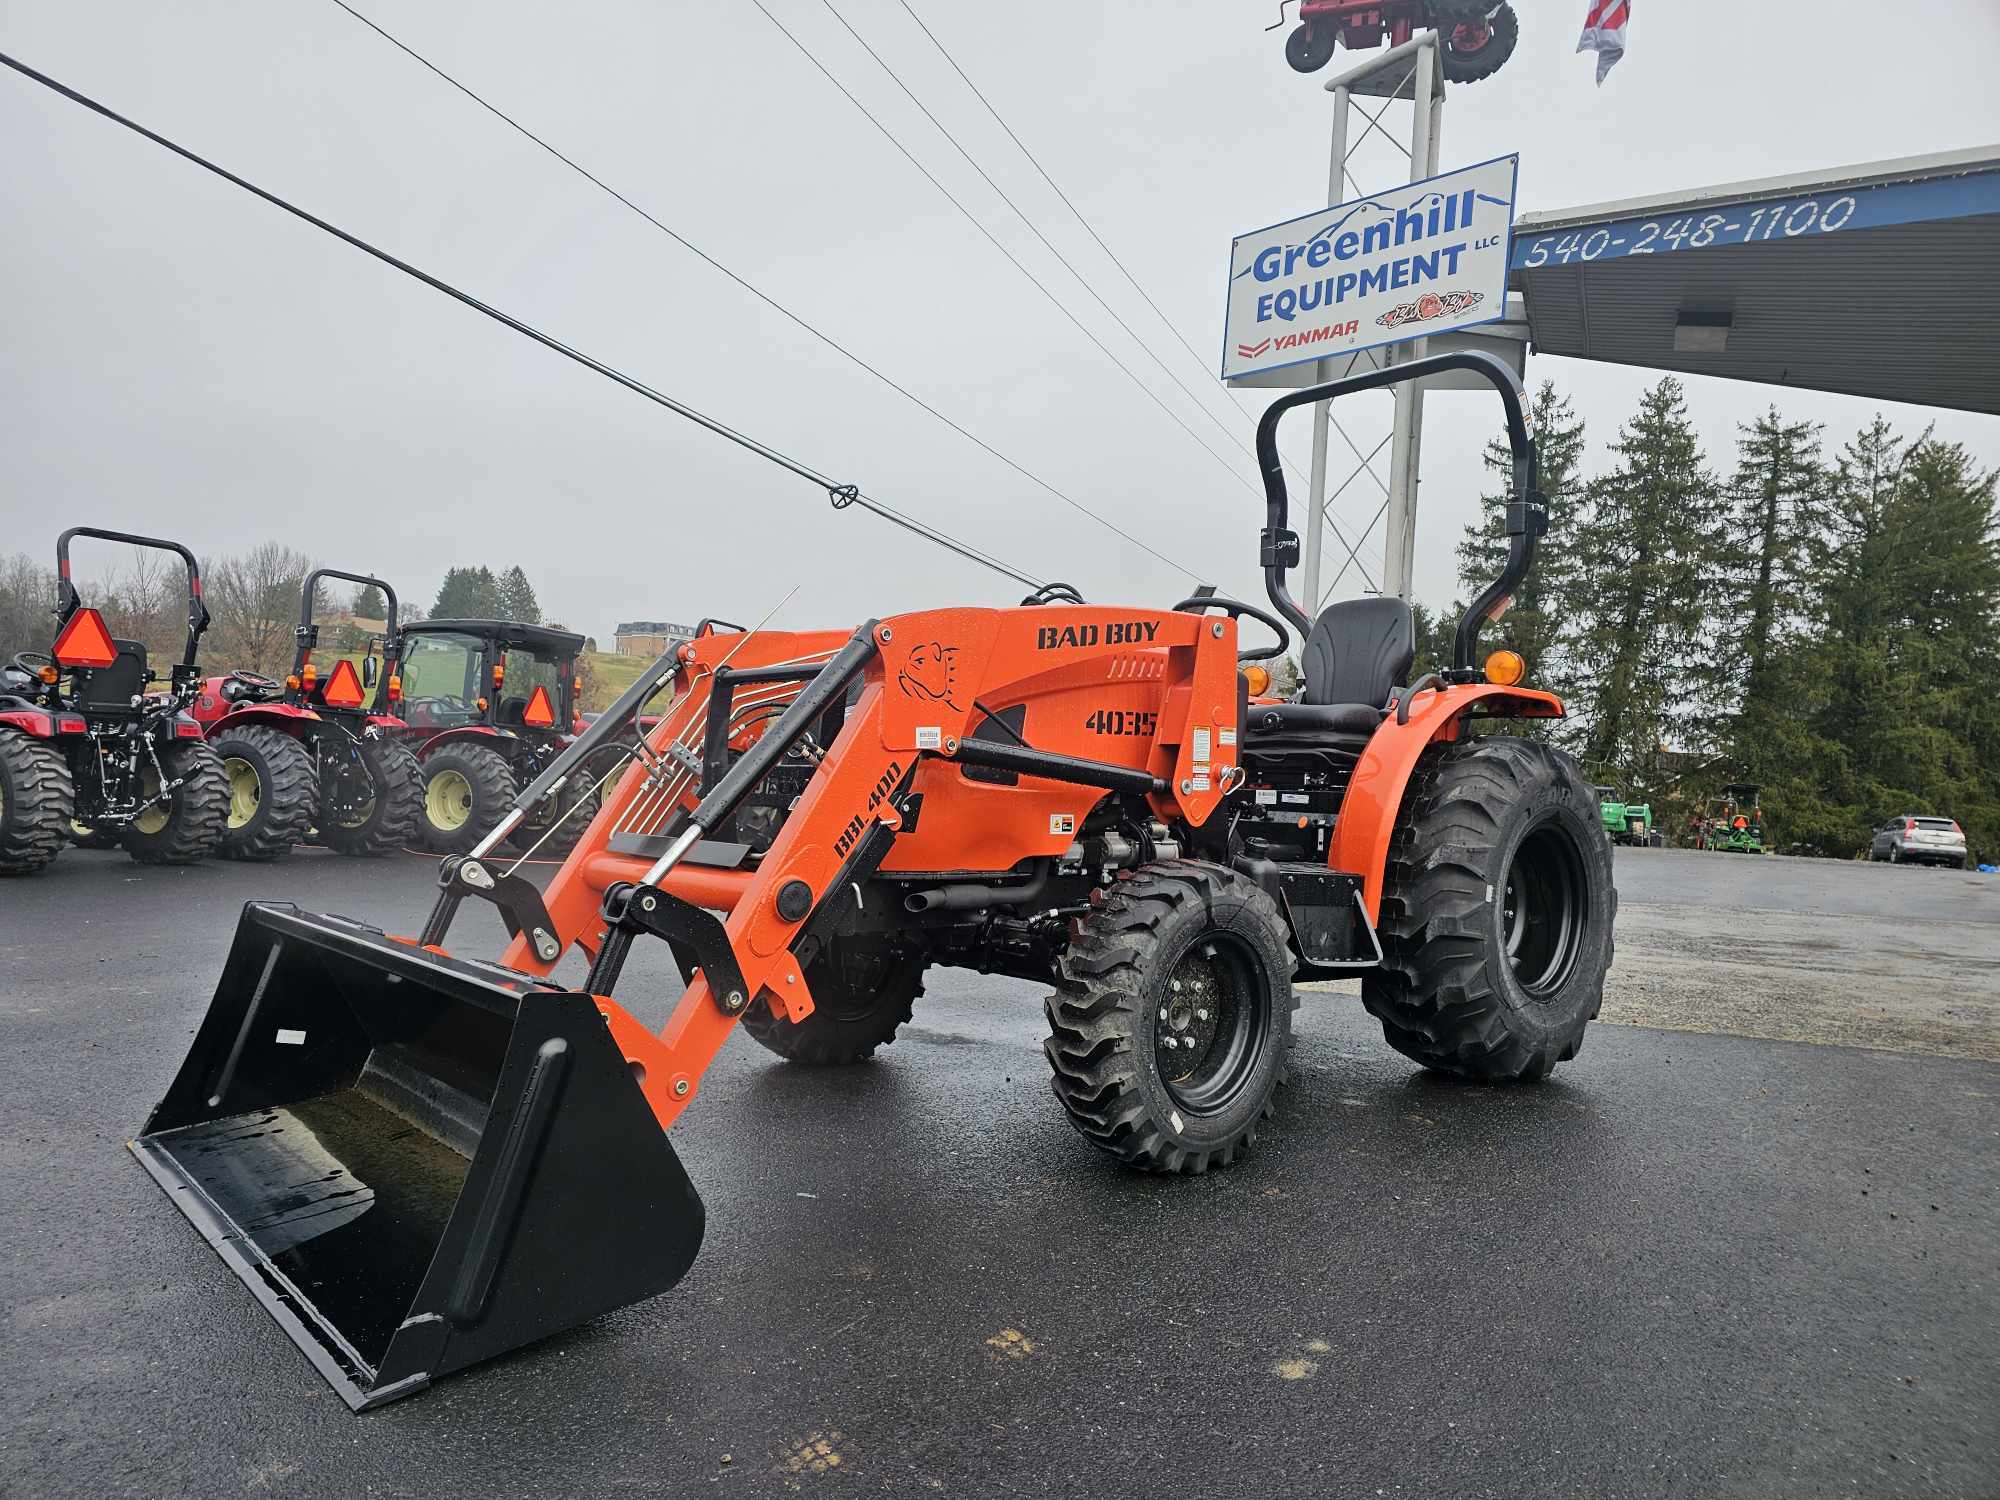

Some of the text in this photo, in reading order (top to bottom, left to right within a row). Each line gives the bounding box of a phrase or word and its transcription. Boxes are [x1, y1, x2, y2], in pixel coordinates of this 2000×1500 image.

[1252, 188, 1475, 283] Greenhill
[1523, 196, 1857, 269] 540-248-1100
[1256, 234, 1500, 323] EQUIPMENT LLC
[1273, 319, 1360, 351] YANMAR
[1037, 620, 1161, 650] BAD BOY
[1085, 710, 1159, 737] 4035
[833, 761, 901, 860] BBL 400
